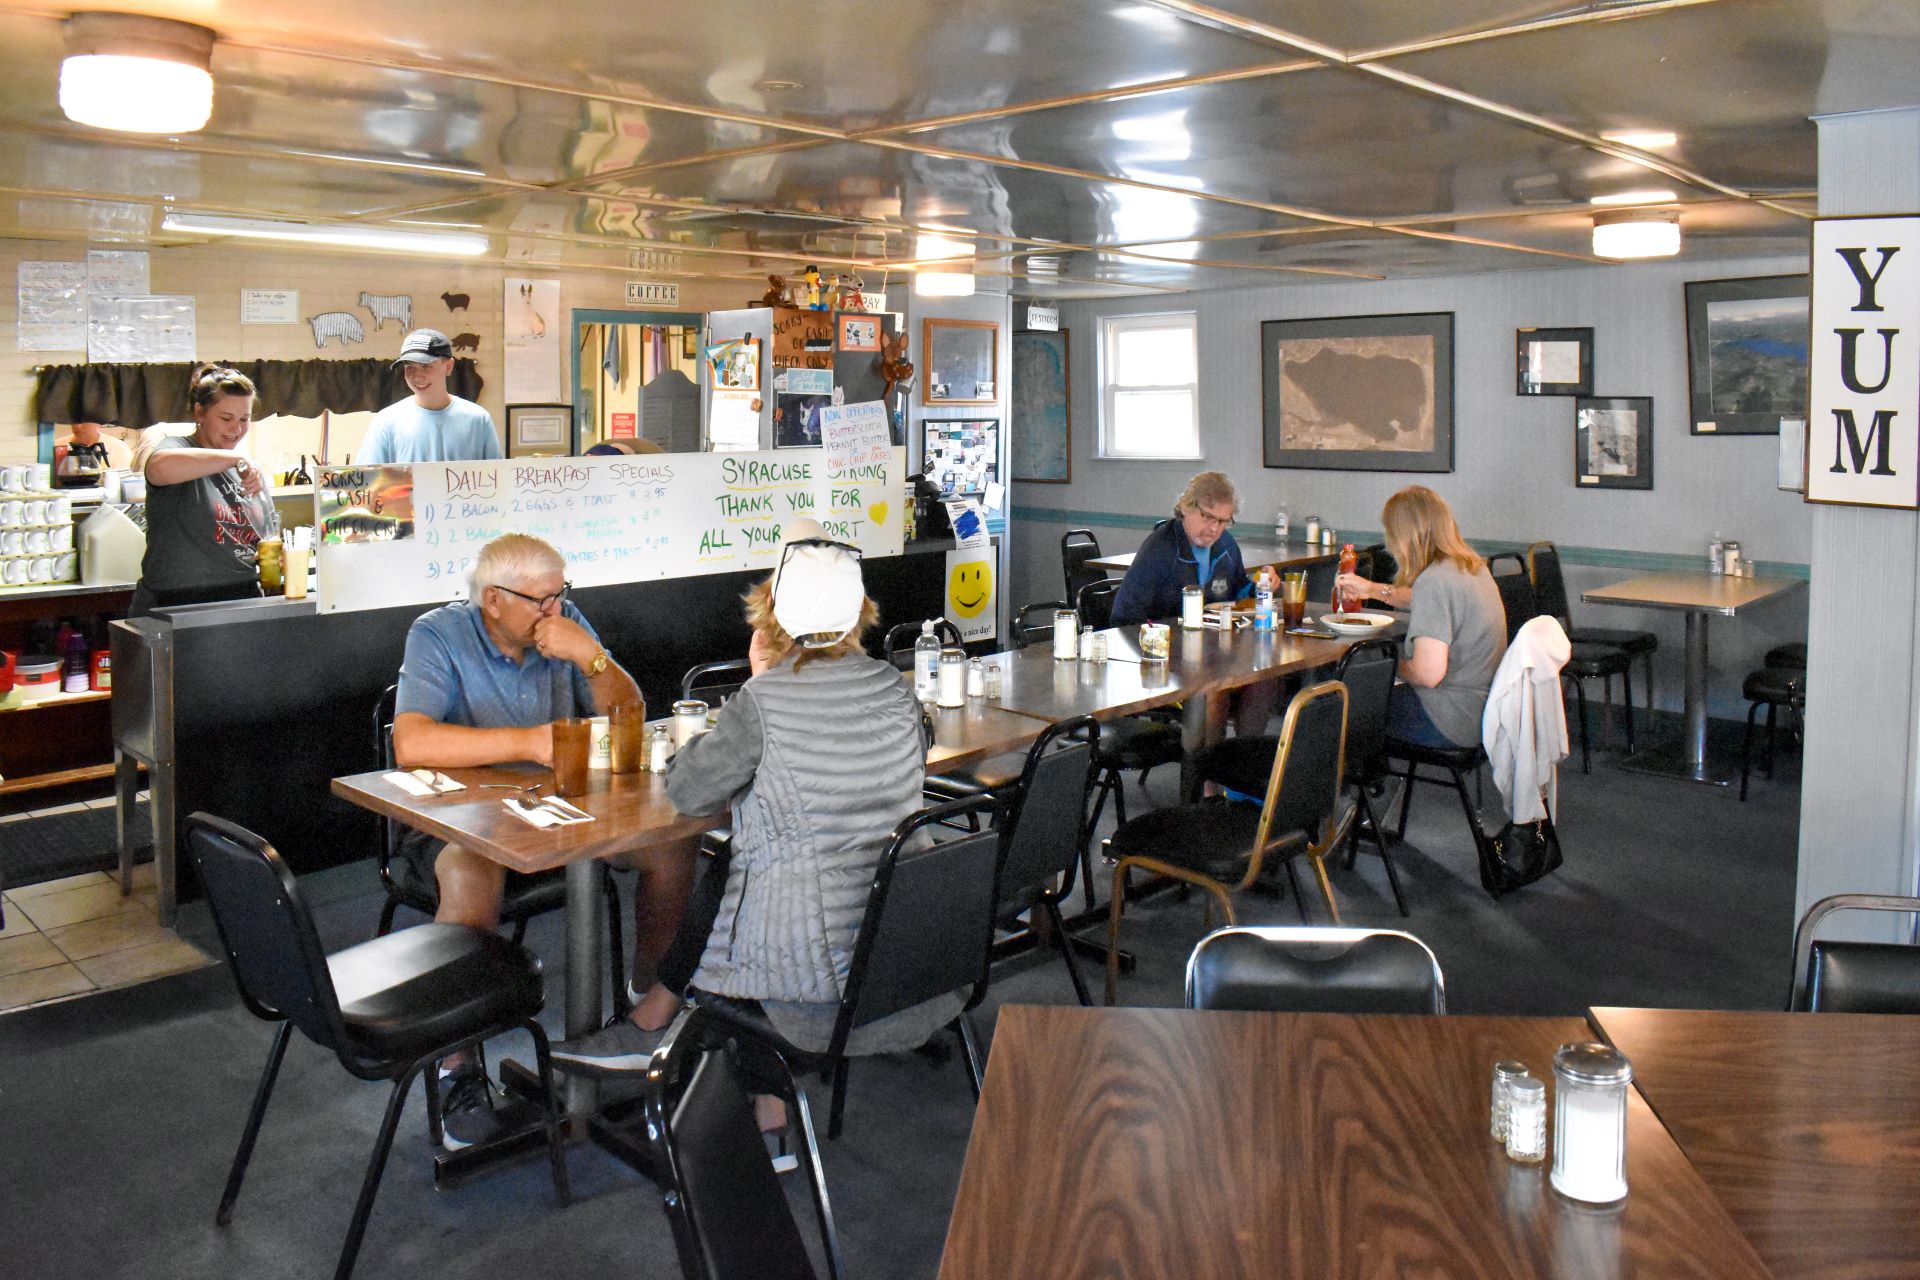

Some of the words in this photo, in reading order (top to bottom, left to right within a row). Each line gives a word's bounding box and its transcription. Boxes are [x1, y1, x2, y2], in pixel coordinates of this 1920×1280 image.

[629, 285, 676, 299] COFFEE
[862, 296, 880, 309] PAY
[806, 327, 828, 339] CASH
[774, 355, 800, 368] CHECK
[806, 355, 828, 368] ONLY
[1829, 246, 1901, 477] YUM
[826, 439, 857, 452] PEANUT
[862, 434, 889, 446] BUTTER
[850, 453, 867, 466] CHIP
[446, 467, 498, 493] DAILY
[513, 466, 598, 488] BREAKFAST
[610, 463, 675, 479] SPECIALS
[722, 458, 813, 485] SYRACUSE
[336, 490, 373, 507] CASH
[374, 497, 384, 514] &
[444, 504, 456, 520] 2
[511, 499, 523, 513] 2
[526, 496, 559, 511] EGGS
[583, 493, 619, 507] TOAST
[715, 493, 774, 517] THANK
[786, 492, 815, 511] YOU
[831, 488, 862, 508] FOR
[325, 518, 368, 535] CHECK
[448, 528, 460, 542] 2
[699, 527, 733, 555] ALL
[742, 524, 781, 548] YOUR
[822, 520, 865, 539] PORT
[446, 560, 457, 574] 2
[968, 628, 979, 636] nice
[98, 657, 111, 667] Ji
